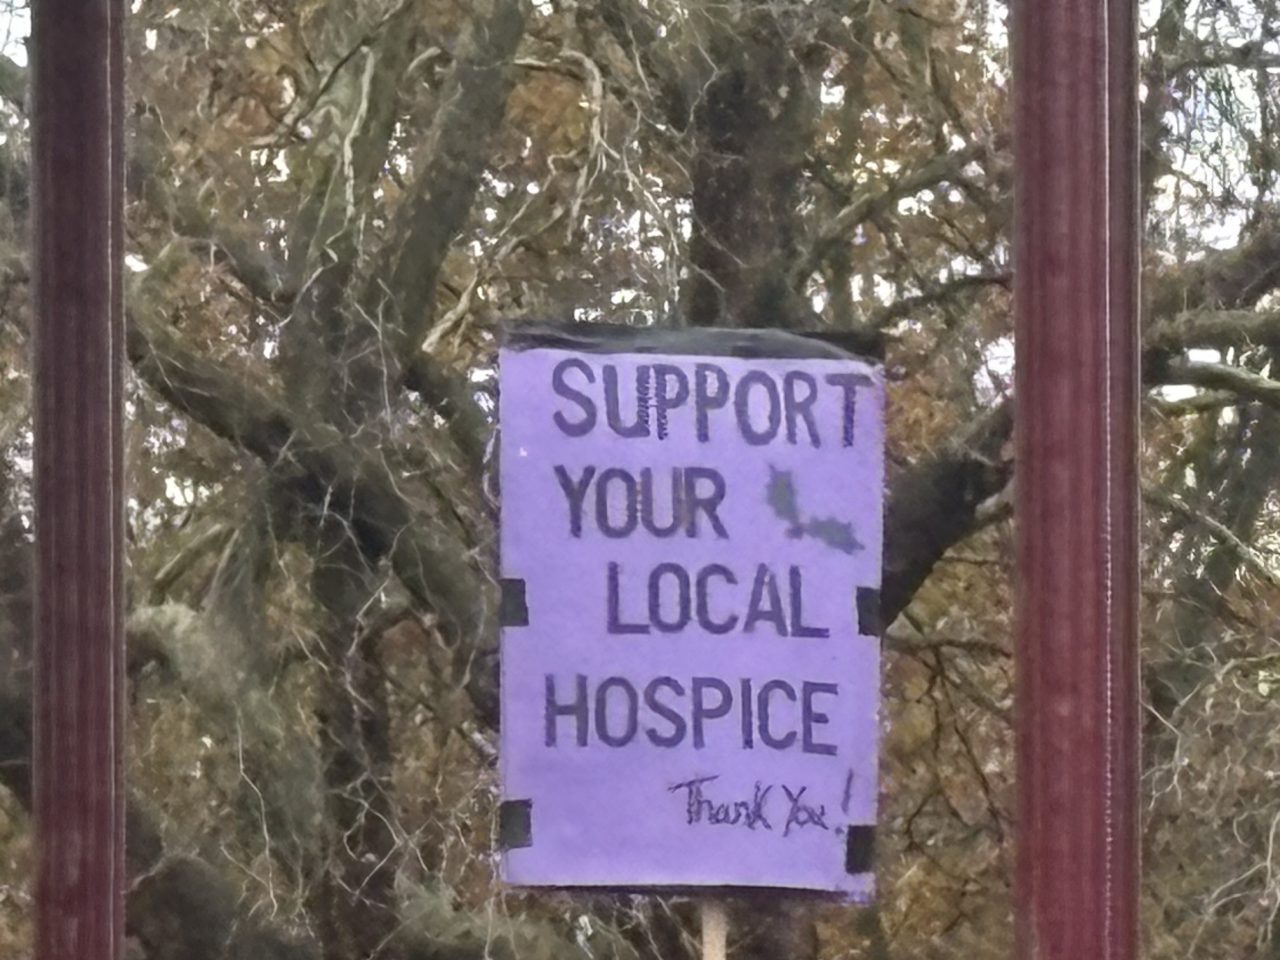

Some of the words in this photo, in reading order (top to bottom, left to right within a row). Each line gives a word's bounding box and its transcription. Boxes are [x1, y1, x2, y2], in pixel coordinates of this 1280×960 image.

[551, 357, 873, 449] SUPPORT
[553, 463, 729, 539] YOUR
[607, 561, 831, 638] LOCAL
[544, 673, 839, 756] HOSPICE
